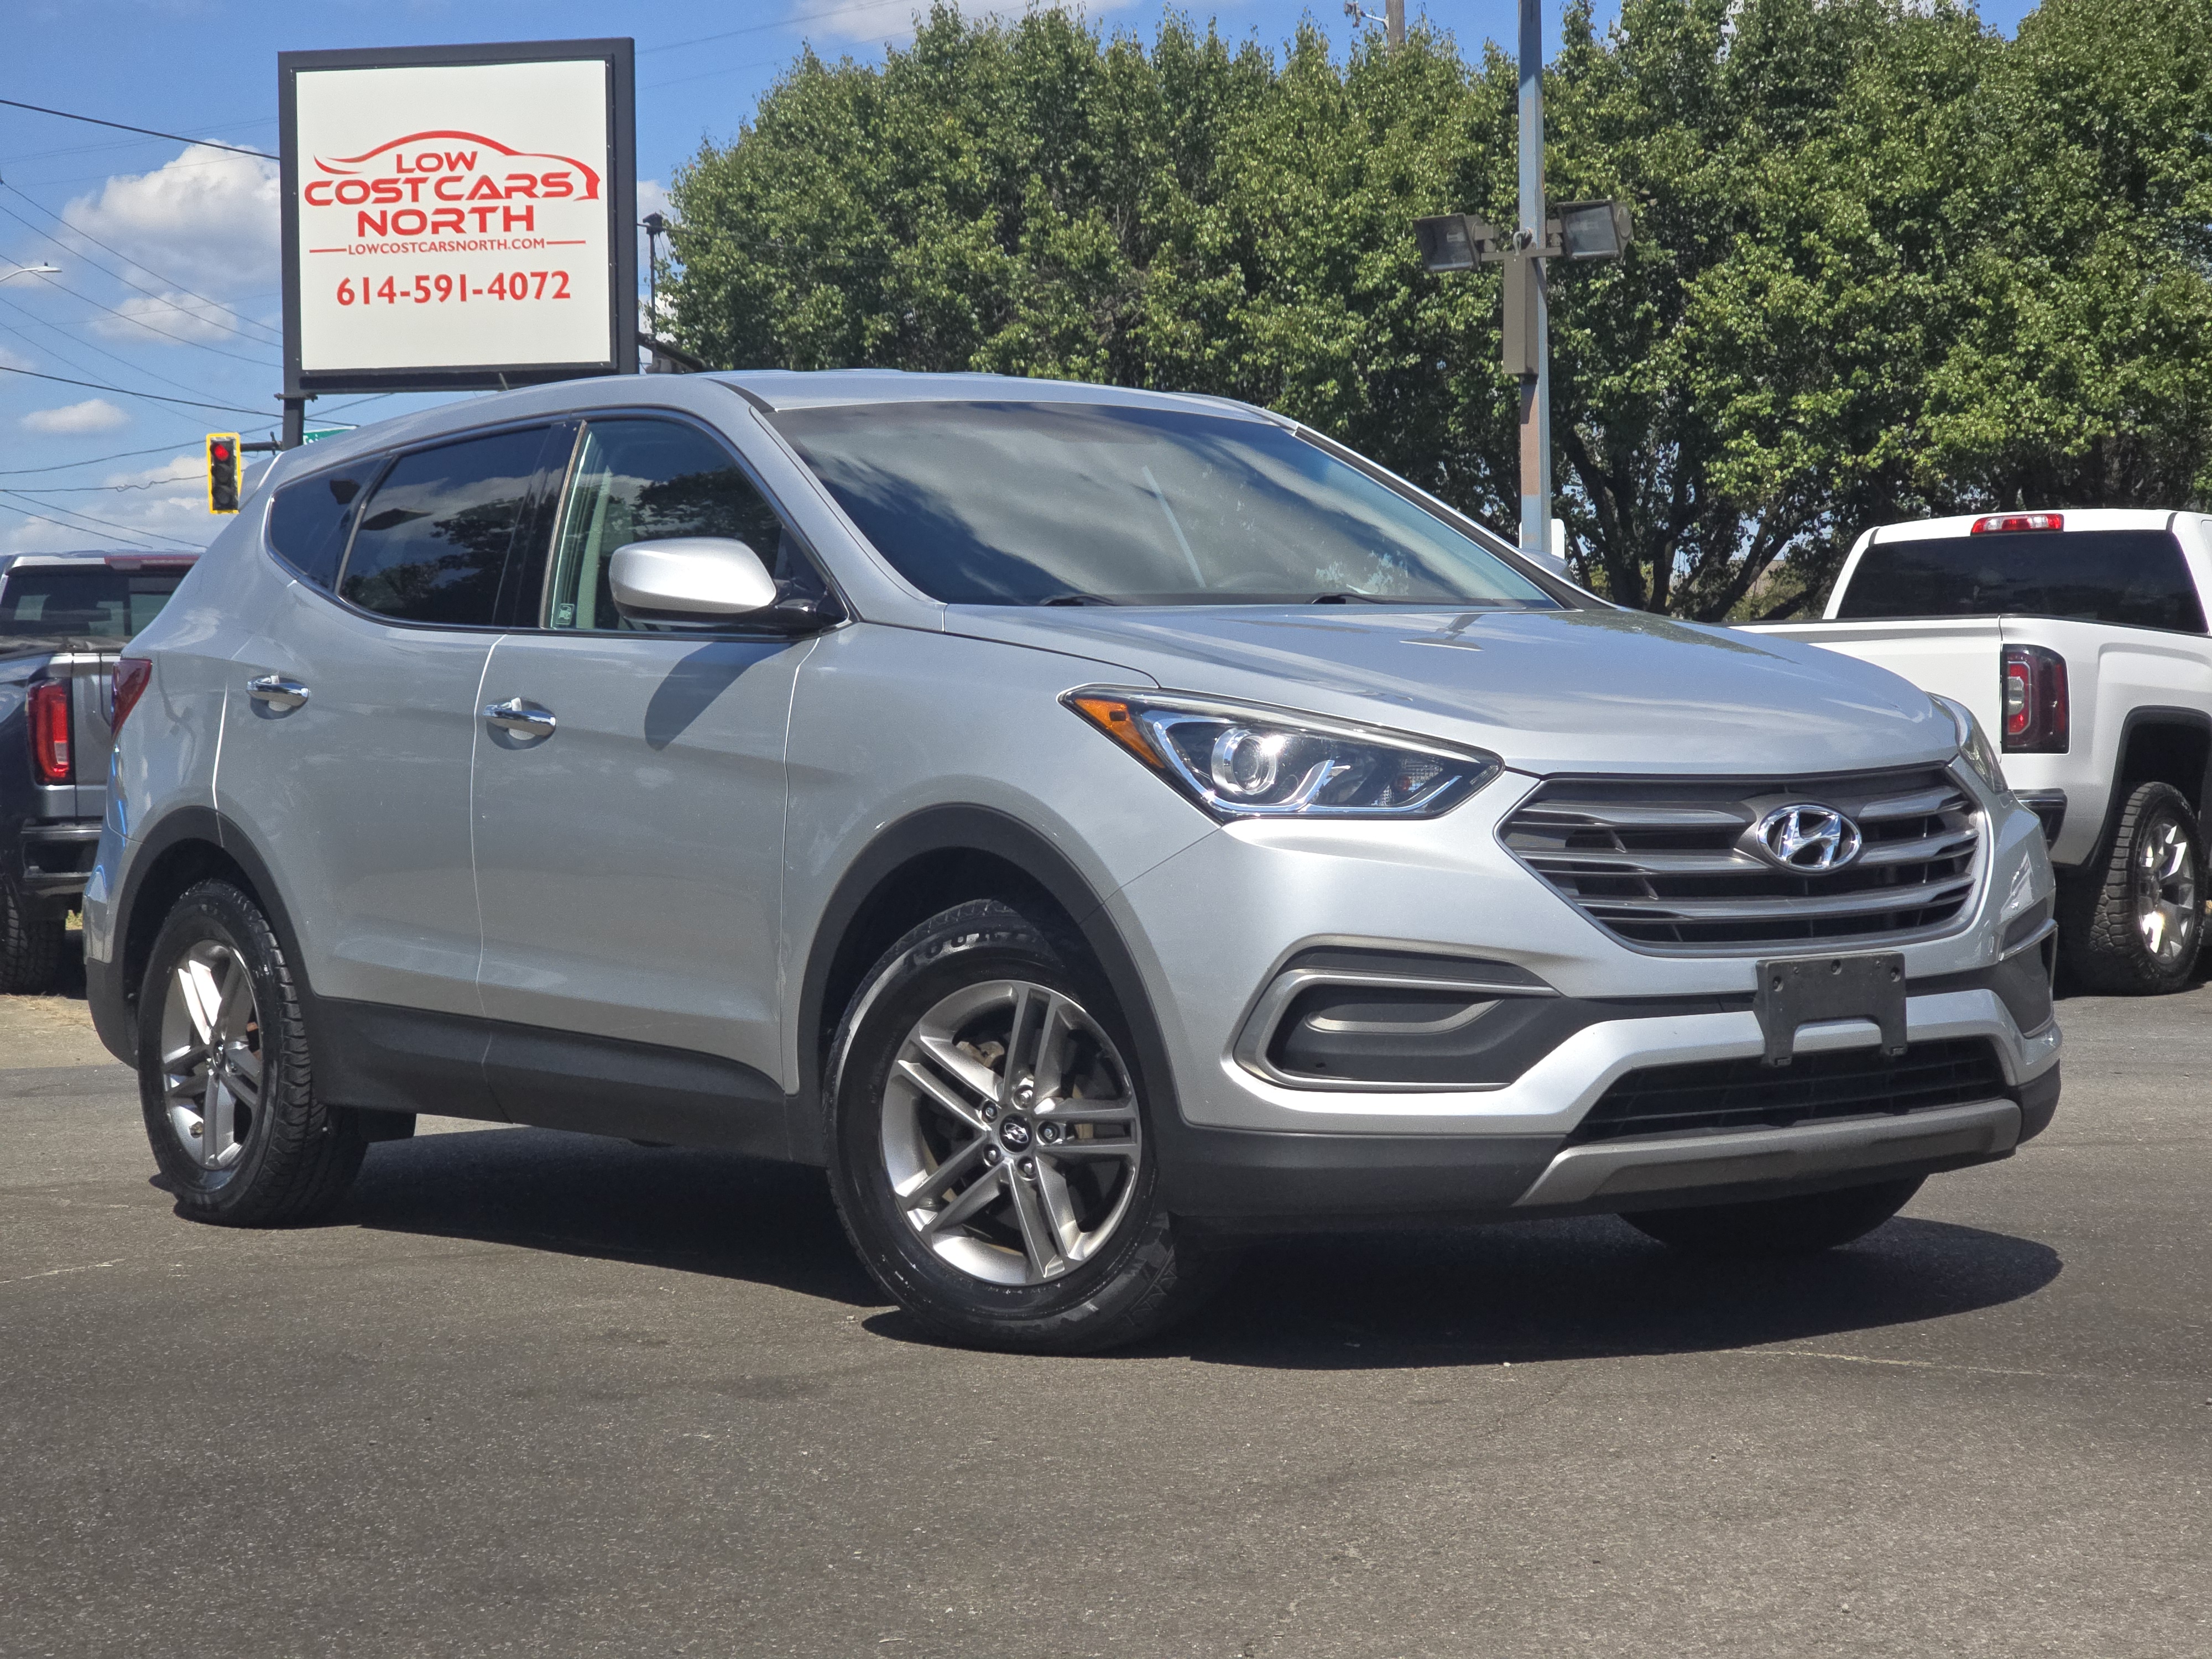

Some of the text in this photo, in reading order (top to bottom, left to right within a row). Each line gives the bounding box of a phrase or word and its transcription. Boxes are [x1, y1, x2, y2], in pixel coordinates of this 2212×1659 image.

[396, 151, 478, 174] LOW
[357, 205, 534, 238] NORTH
[348, 238, 545, 255] LOWCOSTCARSNORTH.COM
[336, 270, 571, 306] 614-591-4072
